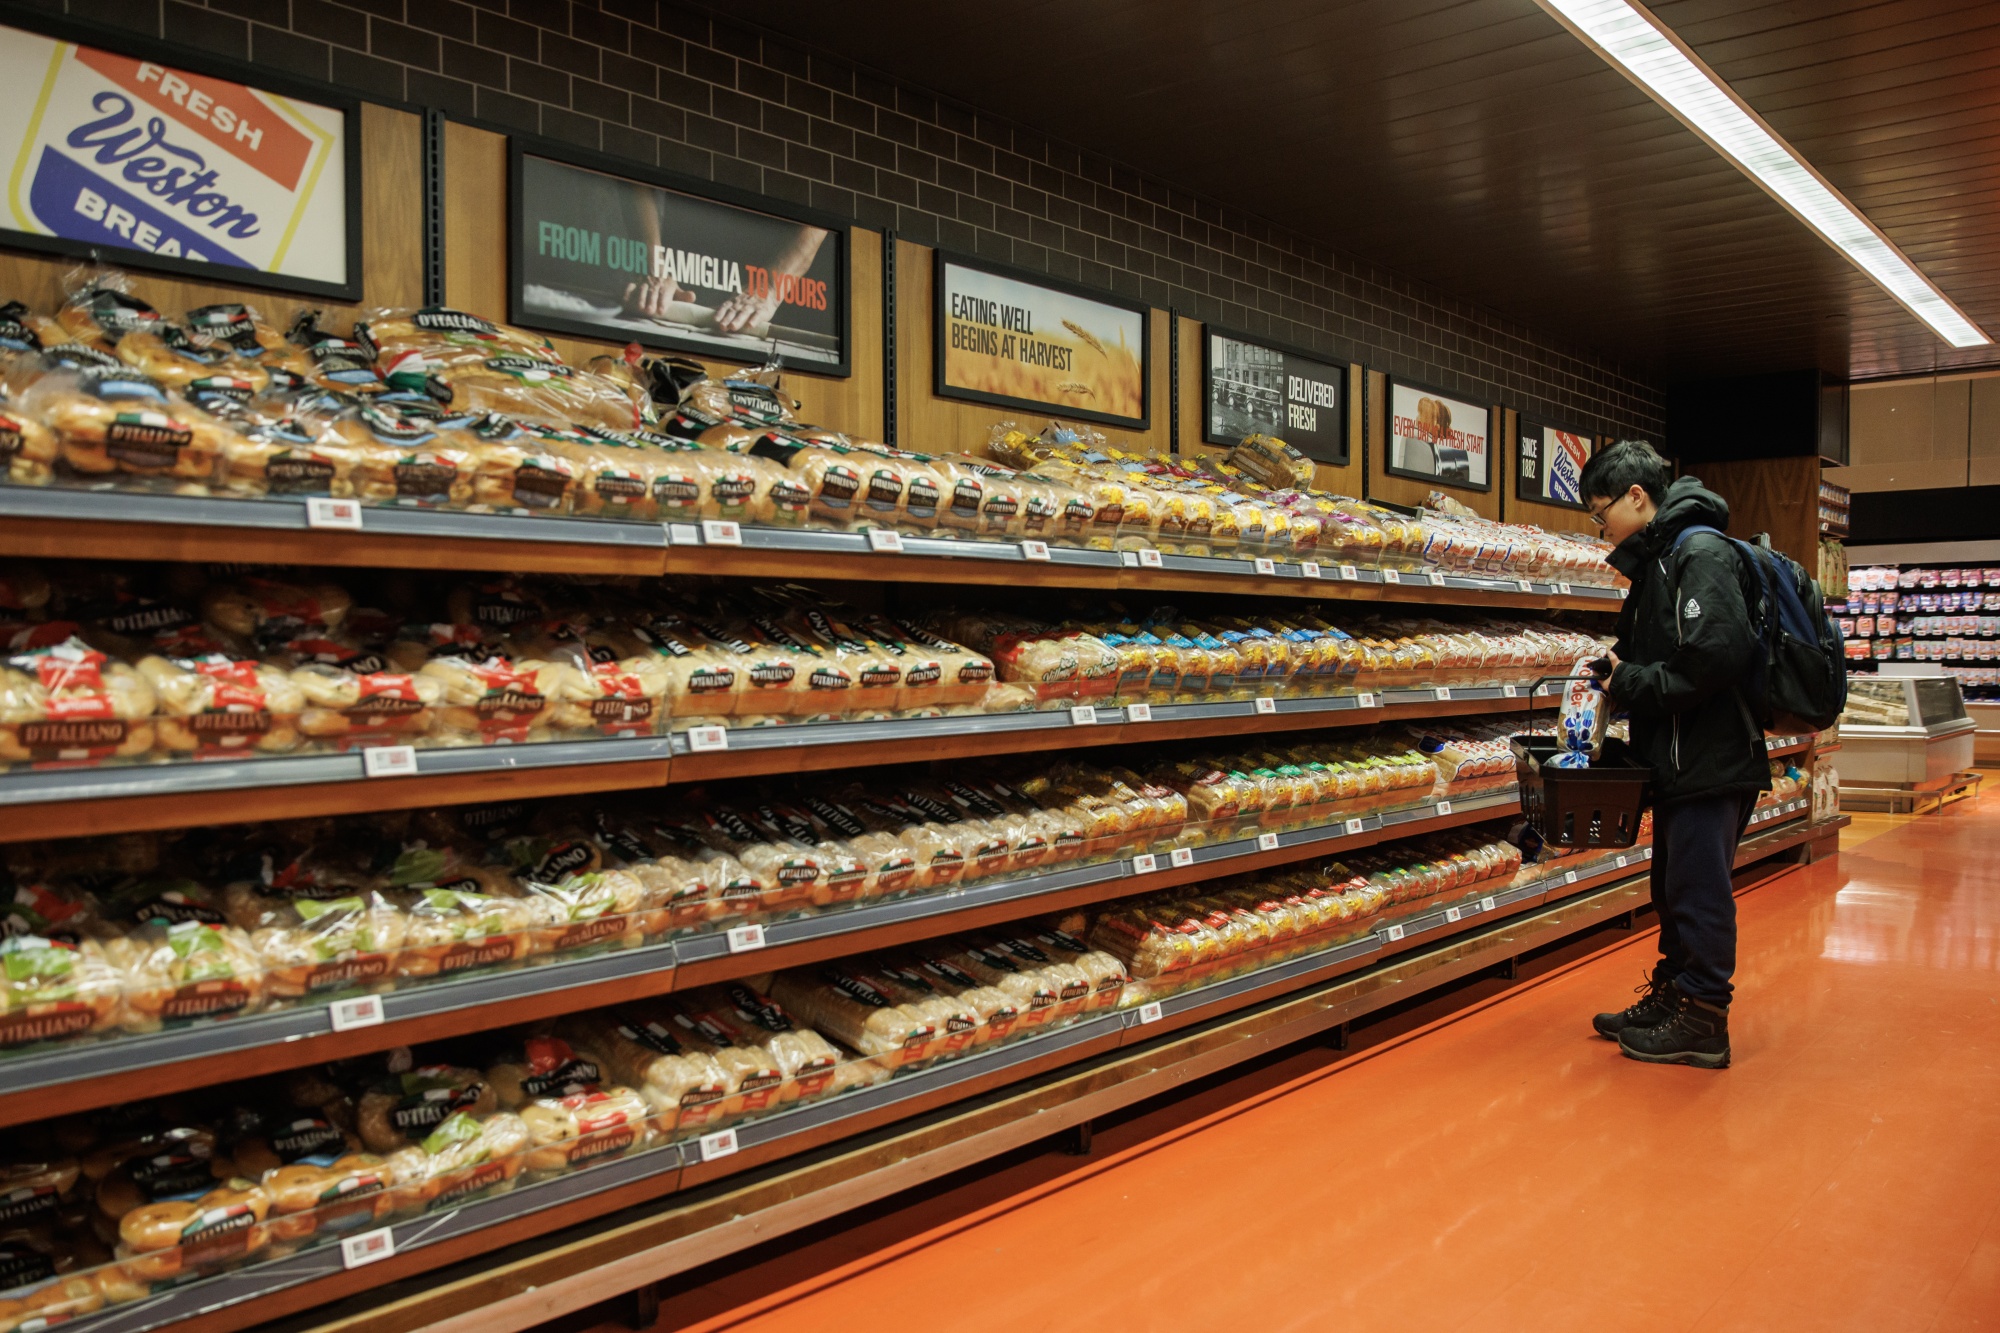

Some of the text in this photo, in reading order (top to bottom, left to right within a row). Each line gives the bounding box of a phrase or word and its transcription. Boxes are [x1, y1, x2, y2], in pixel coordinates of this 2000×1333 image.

[135, 61, 264, 151] FRESH
[66, 91, 261, 239] Weston
[74, 187, 209, 262] BREA
[539, 220, 827, 311] FROM OUR FAMIGLIA TO YOURS
[951, 293, 1034, 336] EATING WELL
[951, 323, 1073, 373] BEGINS AT HARVEST
[1288, 375, 1335, 409] DELIVERED
[1288, 403, 1317, 433] FRESH
[1394, 415, 1416, 438] EVERY
[1417, 421, 1431, 443] DAY
[1446, 428, 1465, 451] FRESH
[1466, 433, 1484, 456] START
[1522, 436, 1538, 459] SINCE
[1562, 431, 1581, 459] FRESH
[1522, 458, 1536, 480] 1882
[1553, 444, 1580, 492] Weston
[1554, 482, 1572, 502] BREA
